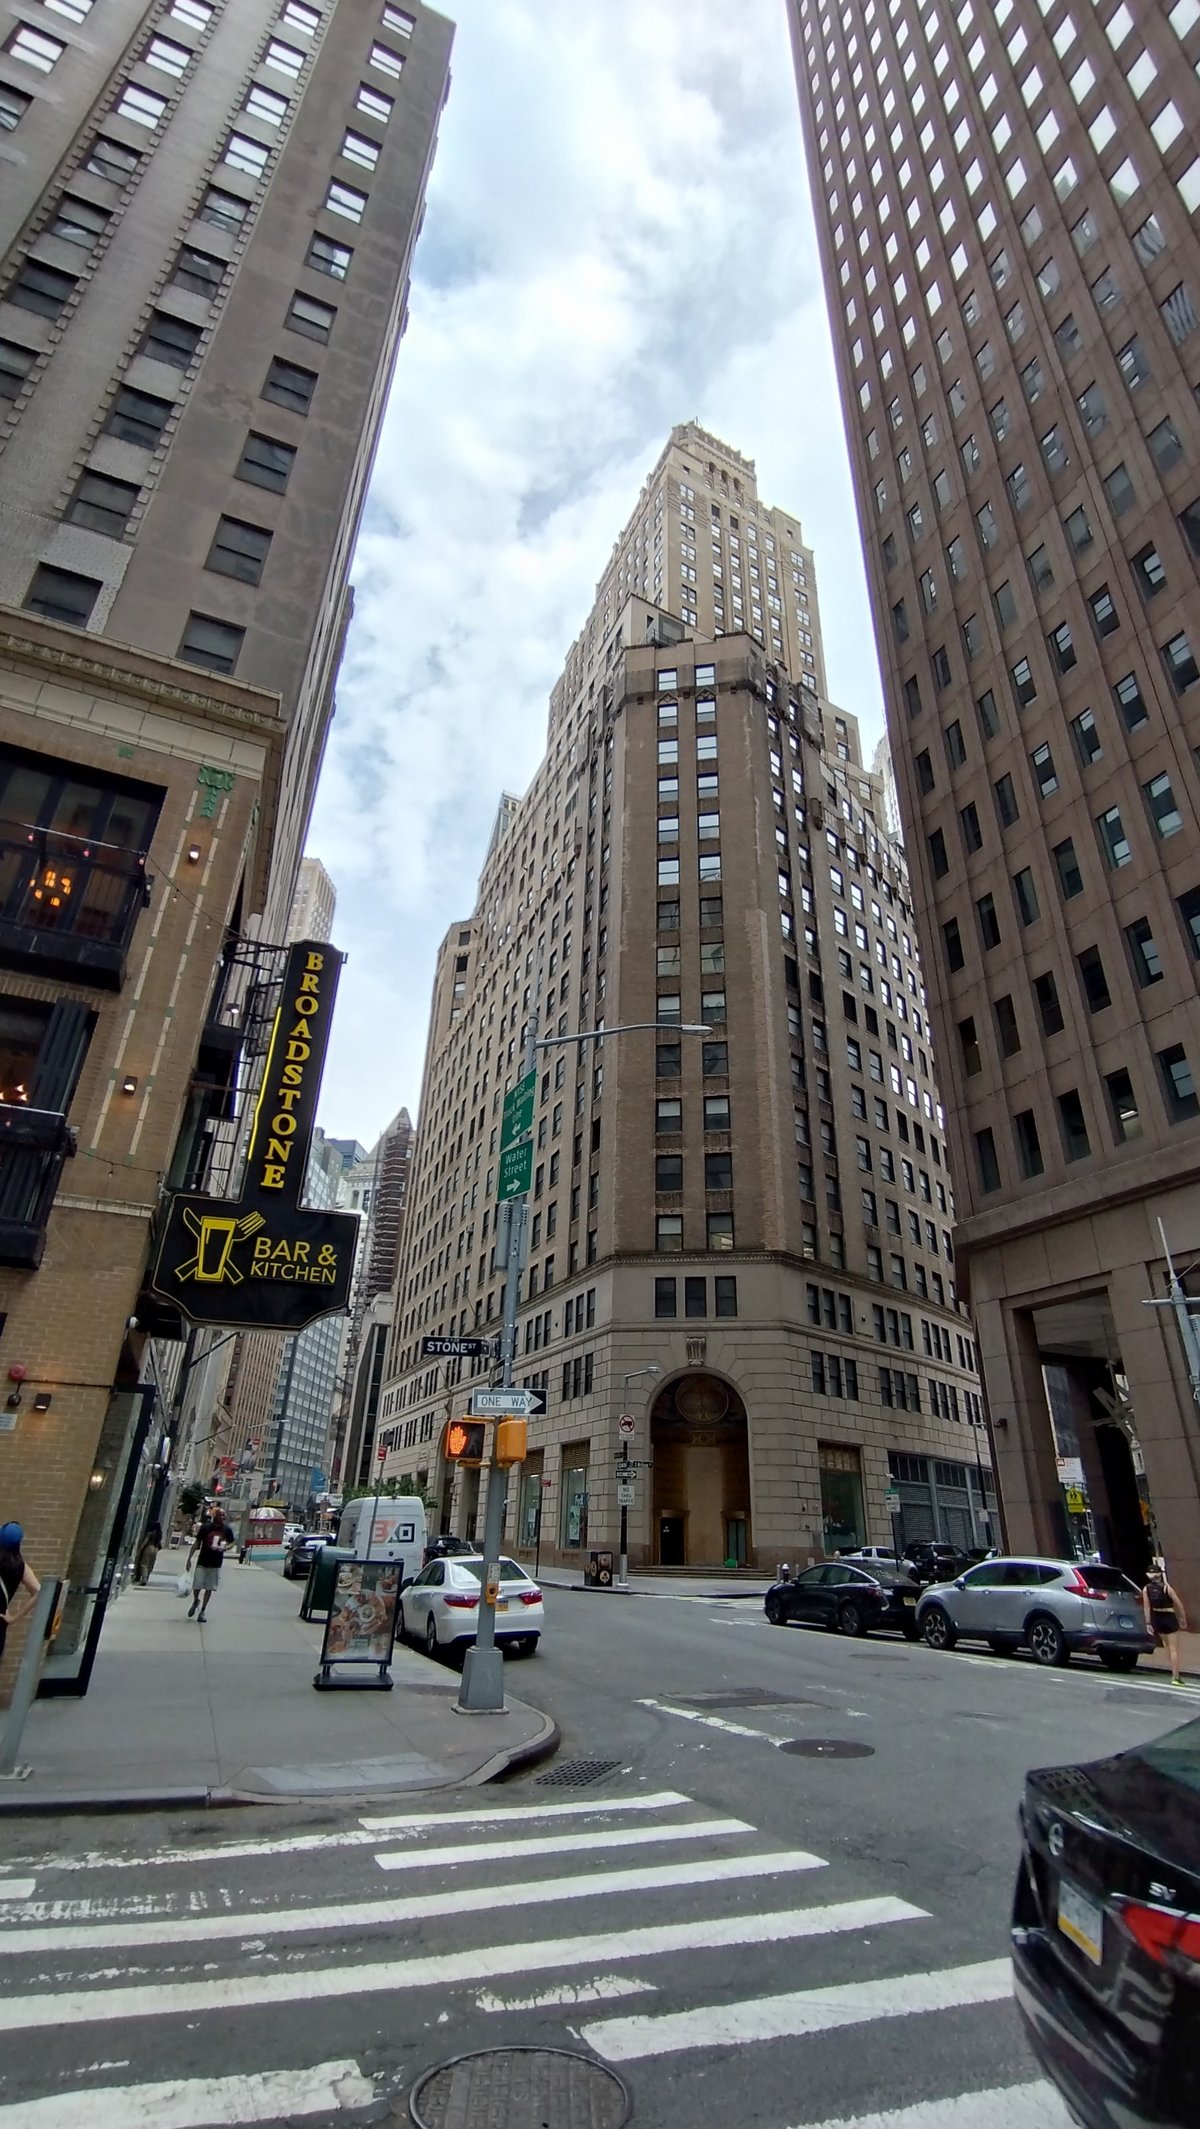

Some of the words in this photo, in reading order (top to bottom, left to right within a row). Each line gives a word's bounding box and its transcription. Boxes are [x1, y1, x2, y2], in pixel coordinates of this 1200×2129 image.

[260, 951, 324, 1190] BROADSTONE
[506, 1148, 528, 1165] Water
[504, 1161, 527, 1178] Street
[254, 1237, 311, 1261] BAR
[320, 1244, 338, 1266] &
[249, 1260, 338, 1284] KITCHEN
[427, 1341, 468, 1354] STONE
[481, 1397, 502, 1407] ONE
[511, 1397, 533, 1407] WAY
